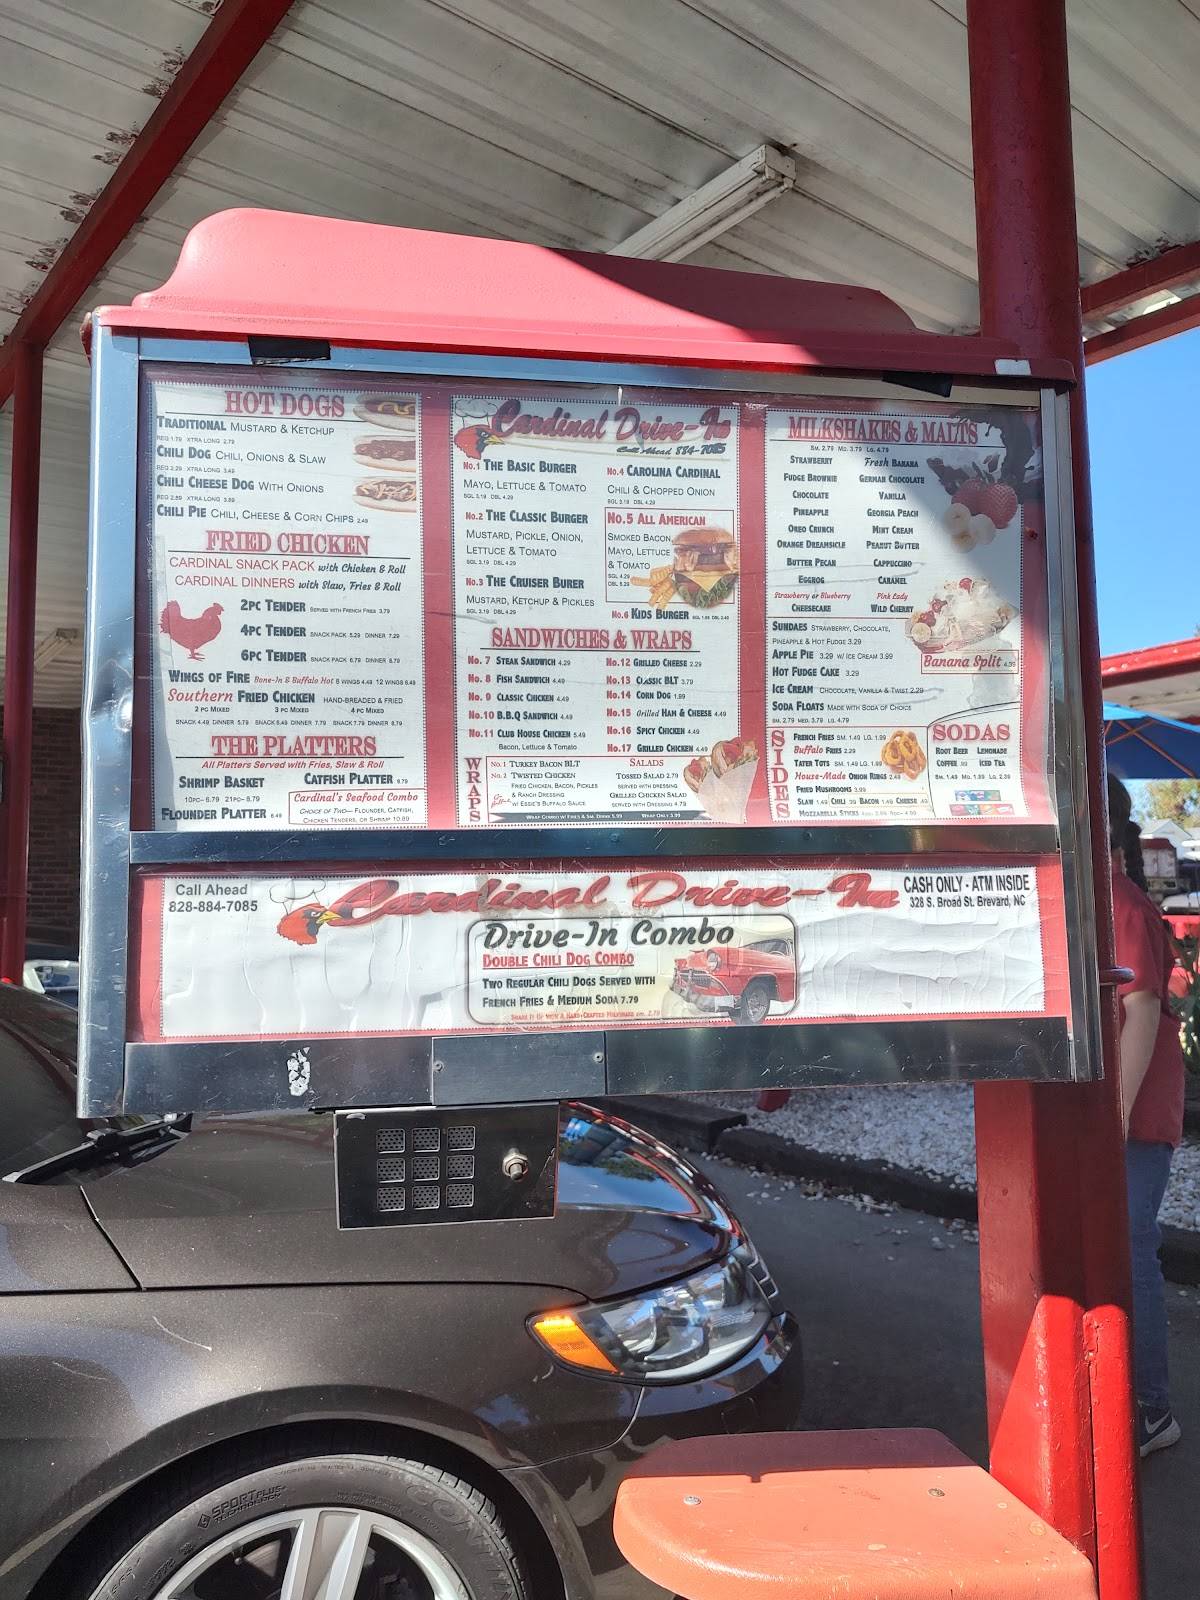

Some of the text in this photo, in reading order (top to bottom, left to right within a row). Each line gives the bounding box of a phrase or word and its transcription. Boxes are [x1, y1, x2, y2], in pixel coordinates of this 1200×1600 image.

[225, 391, 345, 417] HOT DOGS
[157, 416, 334, 435] TRADITIONAL MUSTARD & KETCHUP
[492, 399, 609, 439] Cardinal
[788, 416, 978, 445] MILKSHAKES & MALTS
[157, 445, 326, 464] CHILI DOG CHILI, ONIONS & SLAW
[790, 456, 832, 465] STRAWBERRY
[483, 459, 503, 472] THE
[507, 460, 535, 472] BASIC
[540, 461, 577, 473] BURGER
[865, 457, 918, 468] Fresh BANANA
[627, 465, 672, 477] CAROLINA
[676, 466, 720, 478] CARDINAL
[464, 479, 586, 492] MAYO, LETTUCE & TOMATO
[793, 491, 829, 500] CHOCOLATE
[879, 492, 906, 501] VANILLA
[157, 505, 183, 517] CHILI
[189, 506, 206, 518] PIE
[211, 509, 239, 521] CHILI,
[243, 510, 280, 521] CHEESE
[284, 512, 291, 521] &
[295, 512, 322, 522] CORN
[326, 512, 354, 523] CHIPS
[486, 509, 506, 522] THE
[510, 510, 547, 522] CLASSIC
[550, 511, 588, 523] BURGER
[637, 514, 656, 524] ALL
[659, 514, 705, 525] AMERICAN
[206, 530, 370, 555] FRIED CHICKEN
[170, 557, 406, 574] CARDINAL SNACK PACK with Chicken & Roll
[486, 575, 506, 587] THE
[510, 575, 548, 588] CRUISER
[553, 577, 584, 589] BURER
[241, 599, 306, 612] 2PC TENDER
[241, 624, 306, 637] 4PC TENDER
[491, 627, 692, 649] SANDWICHES & WRAPS
[485, 656, 491, 664] 7
[496, 656, 518, 666] STEAK
[521, 656, 555, 666] SANDWICH
[772, 650, 797, 660] APPLE
[800, 650, 813, 659] PIE
[924, 655, 1002, 669] Banana Split
[168, 670, 204, 683] WINGS
[209, 672, 222, 683] OF
[226, 671, 250, 684] FIRE
[292, 676, 318, 685] Buffalo
[321, 677, 333, 685] Hot
[772, 667, 788, 677] HOT
[792, 667, 817, 677] FUDGE
[820, 667, 839, 677] CAKE
[168, 688, 315, 703] Southern FRIED CHICKEN
[637, 691, 654, 699] CORN
[656, 691, 671, 699] DOG
[772, 701, 824, 712] SODA FLOATS
[933, 724, 1010, 741] SODAS
[211, 736, 376, 756] THE PLATTERS
[219, 761, 251, 769] Platters
[254, 761, 286, 769] Served
[309, 761, 332, 769] Fries,
[368, 761, 384, 769] Roll
[565, 760, 580, 768] BLT
[304, 772, 393, 785] CATFISH PLATTER
[771, 729, 790, 819] SIDES
[795, 772, 846, 780] House-Made
[465, 757, 482, 823] WRAPS
[294, 793, 418, 802] Cardinal's Seafood Combo
[161, 808, 266, 821] FLOUNDER PLATTER
[176, 884, 248, 895] Call Ahead
[904, 875, 1030, 893] CASH ONLY ATM INSIDE
[169, 900, 258, 913] 828-884-7085
[328, 877, 609, 927] Cardinal
[910, 895, 1025, 908] 328 S. Broad St. Brevard, NC
[483, 920, 734, 949] Drive-In Combo
[483, 952, 634, 967] DOUBLE CHILI DOG COMBO
[483, 976, 655, 989] TWO REGULAR CHILI DOGS SERVED WITH
[483, 995, 639, 1008] FRENCH FRIES & MEDIUM SODA 7.79
